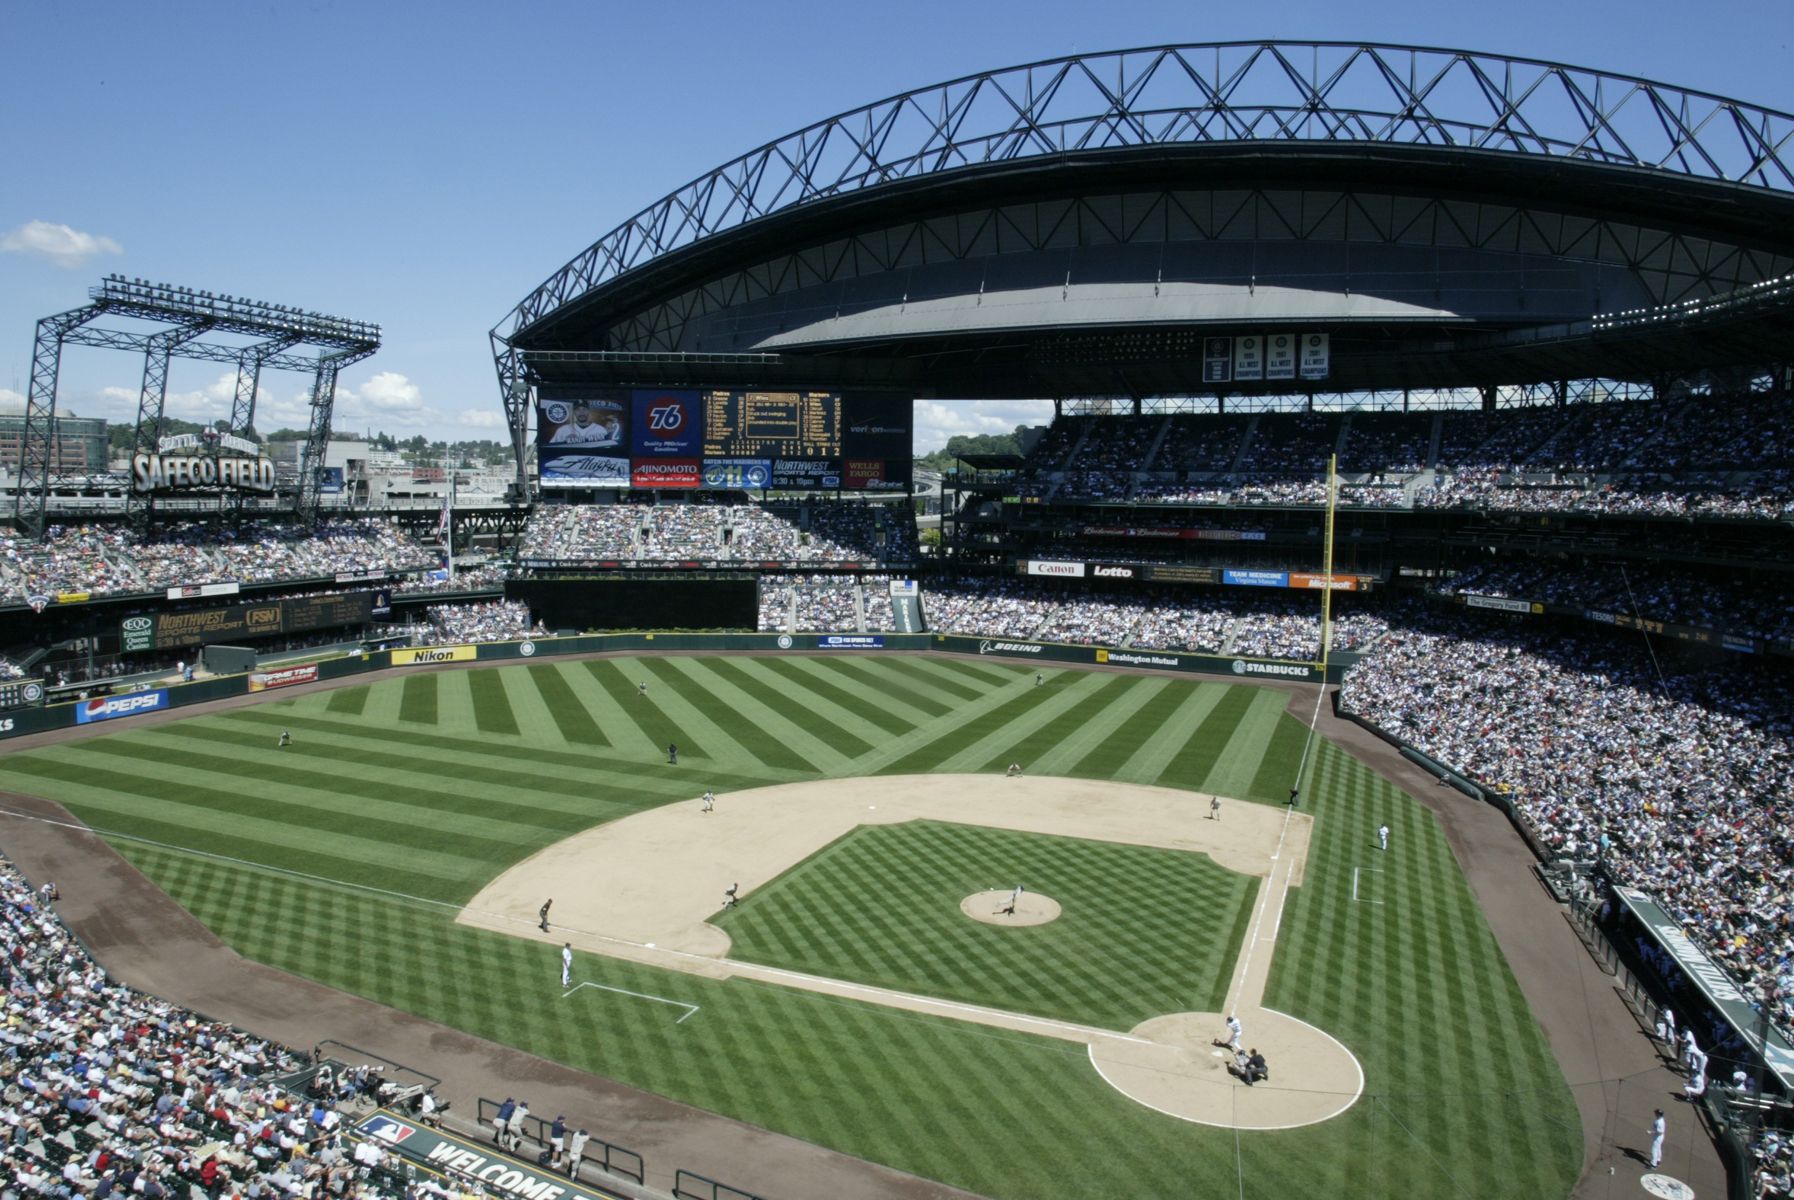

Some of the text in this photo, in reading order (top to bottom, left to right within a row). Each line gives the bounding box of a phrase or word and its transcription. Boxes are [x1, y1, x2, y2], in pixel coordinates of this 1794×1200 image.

[650, 404, 682, 430] 76
[566, 456, 618, 473] Alaska
[634, 464, 698, 474] AJINOMOTO
[773, 460, 830, 470] NORTHWEST
[134, 454, 276, 492] SAFECO FIELD
[1138, 528, 1180, 537] Budweiser
[1038, 564, 1080, 575] Canon
[1094, 566, 1133, 578] Lotto
[159, 610, 227, 630] NORTHWEST
[252, 610, 274, 623] FSN
[1592, 611, 1614, 622] TESORO
[128, 618, 148, 629] EQC
[159, 621, 243, 637] SPORTS REPORT
[124, 629, 151, 638] Emerald
[994, 643, 1042, 653] BOEING
[414, 650, 453, 662] Nikon
[1108, 654, 1178, 667] Washington Mutual
[1246, 663, 1309, 676] STARBUCKS
[106, 693, 160, 714] PEPSI
[428, 1141, 565, 1200] WELCOME
